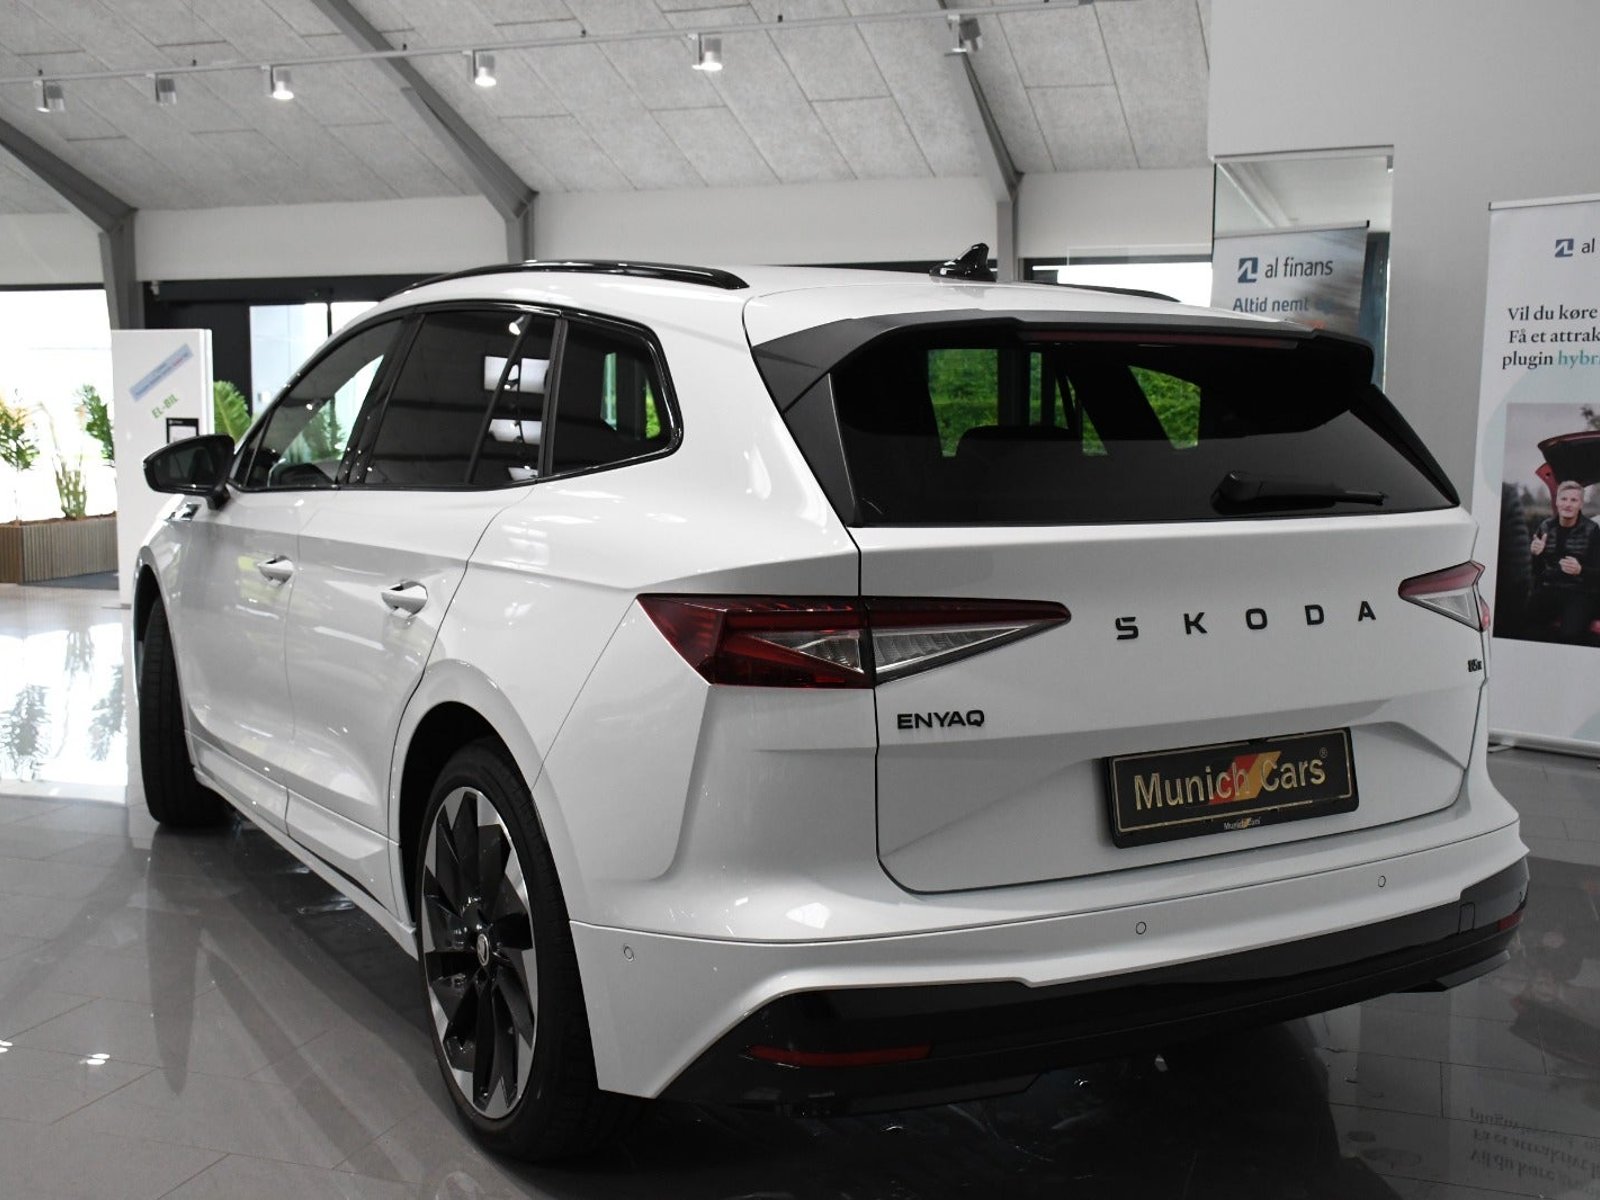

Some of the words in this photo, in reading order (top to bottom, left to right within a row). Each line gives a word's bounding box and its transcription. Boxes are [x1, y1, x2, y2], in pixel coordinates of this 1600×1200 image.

[1581, 237, 1596, 254] al
[1264, 256, 1279, 279] al
[1283, 256, 1334, 278] finans
[1232, 296, 1269, 313] Altid
[1271, 296, 1310, 312] nemt
[1507, 305, 1530, 321] Vil
[1533, 304, 1555, 321] du
[1558, 304, 1598, 321] køre
[1509, 327, 1527, 344] Få
[1530, 331, 1546, 343] et
[1501, 350, 1553, 370] plugin
[1557, 350, 1600, 369] hybr
[1115, 600, 1377, 641] SKODA
[896, 709, 985, 730] ENYAQ
[1133, 761, 1250, 811] Munich
